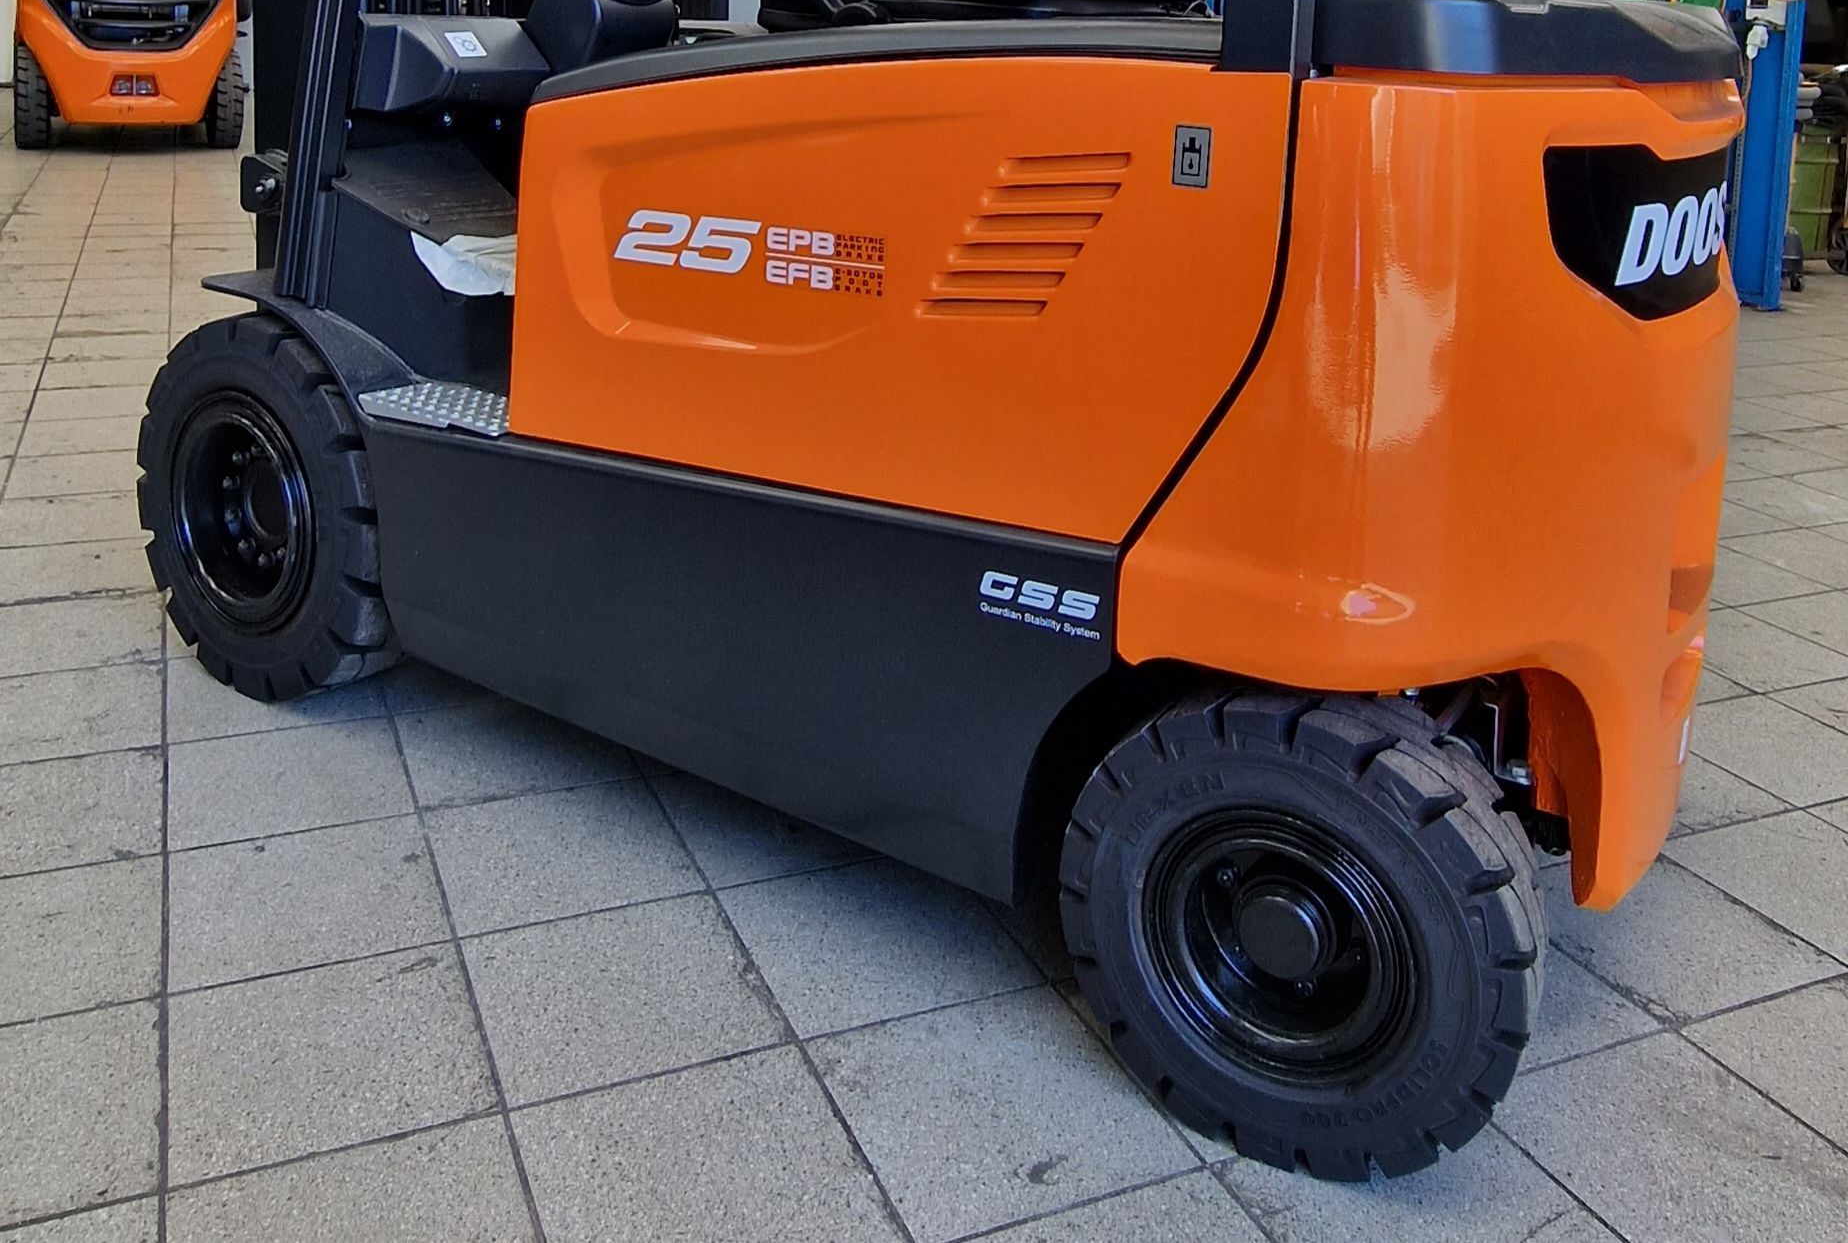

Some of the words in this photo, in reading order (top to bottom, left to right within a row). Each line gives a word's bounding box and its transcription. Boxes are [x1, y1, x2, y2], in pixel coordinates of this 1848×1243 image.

[613, 208, 763, 275] 25
[766, 226, 835, 257] EPB
[836, 233, 885, 245] ELECTRIC
[836, 242, 885, 254] PARKING
[835, 250, 884, 263] BRAKE
[765, 259, 834, 291] EFB
[835, 275, 883, 289] FOOT
[834, 284, 883, 297] BRAKE
[979, 570, 1100, 620] GSS
[979, 601, 1023, 622] Guardian
[1024, 612, 1062, 633] Stability
[1063, 622, 1100, 641] System
